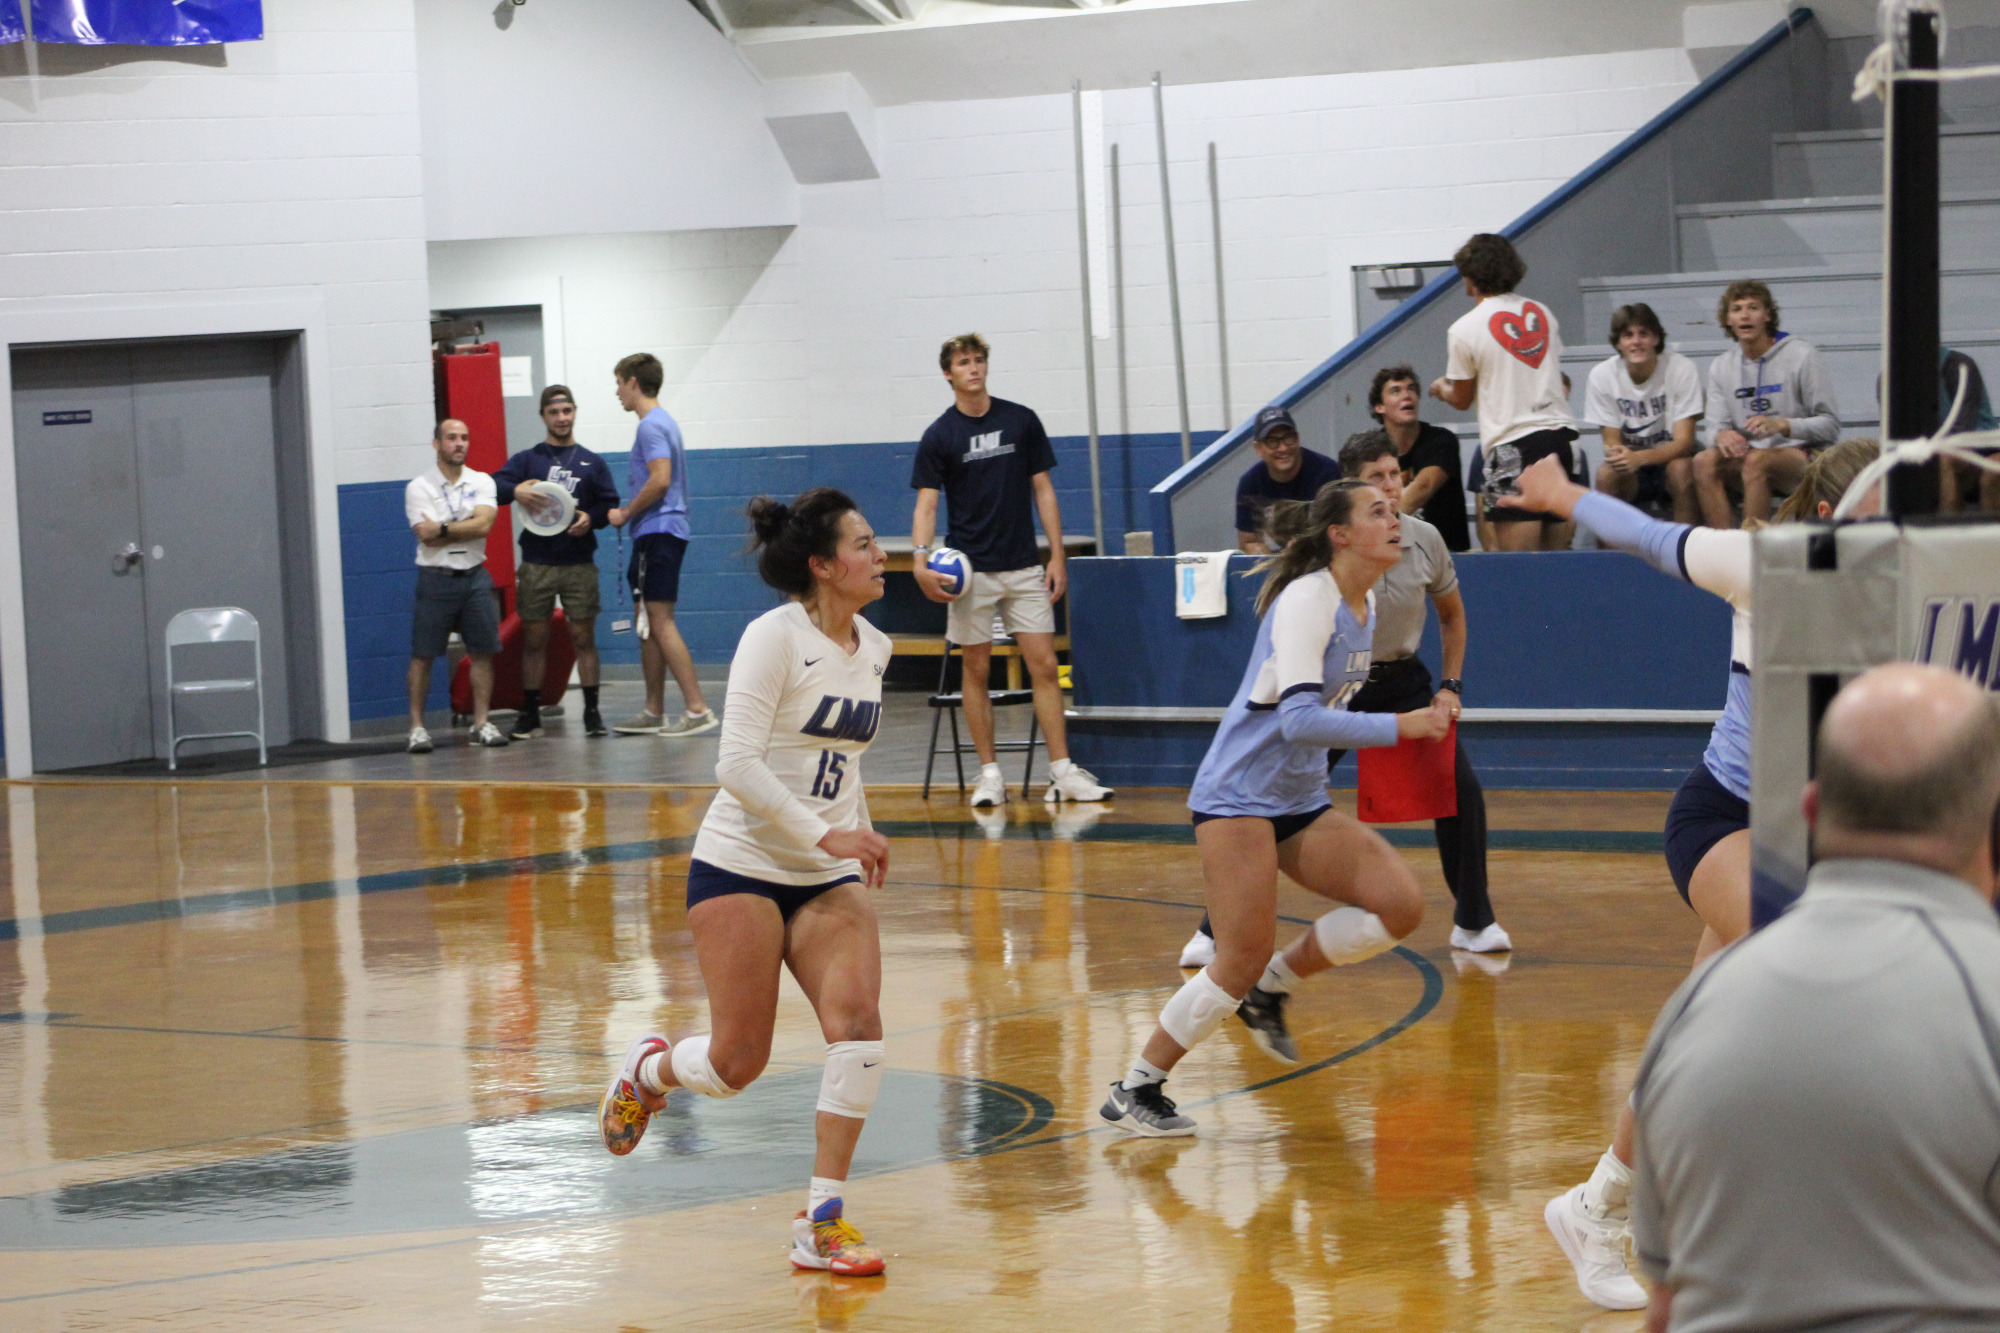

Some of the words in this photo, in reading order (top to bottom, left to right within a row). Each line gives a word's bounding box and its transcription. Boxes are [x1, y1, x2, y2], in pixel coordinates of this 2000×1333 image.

[969, 430, 1003, 452] LMU
[547, 465, 581, 494] LMU
[800, 694, 881, 743] LMU
[810, 749, 847, 800] 15
